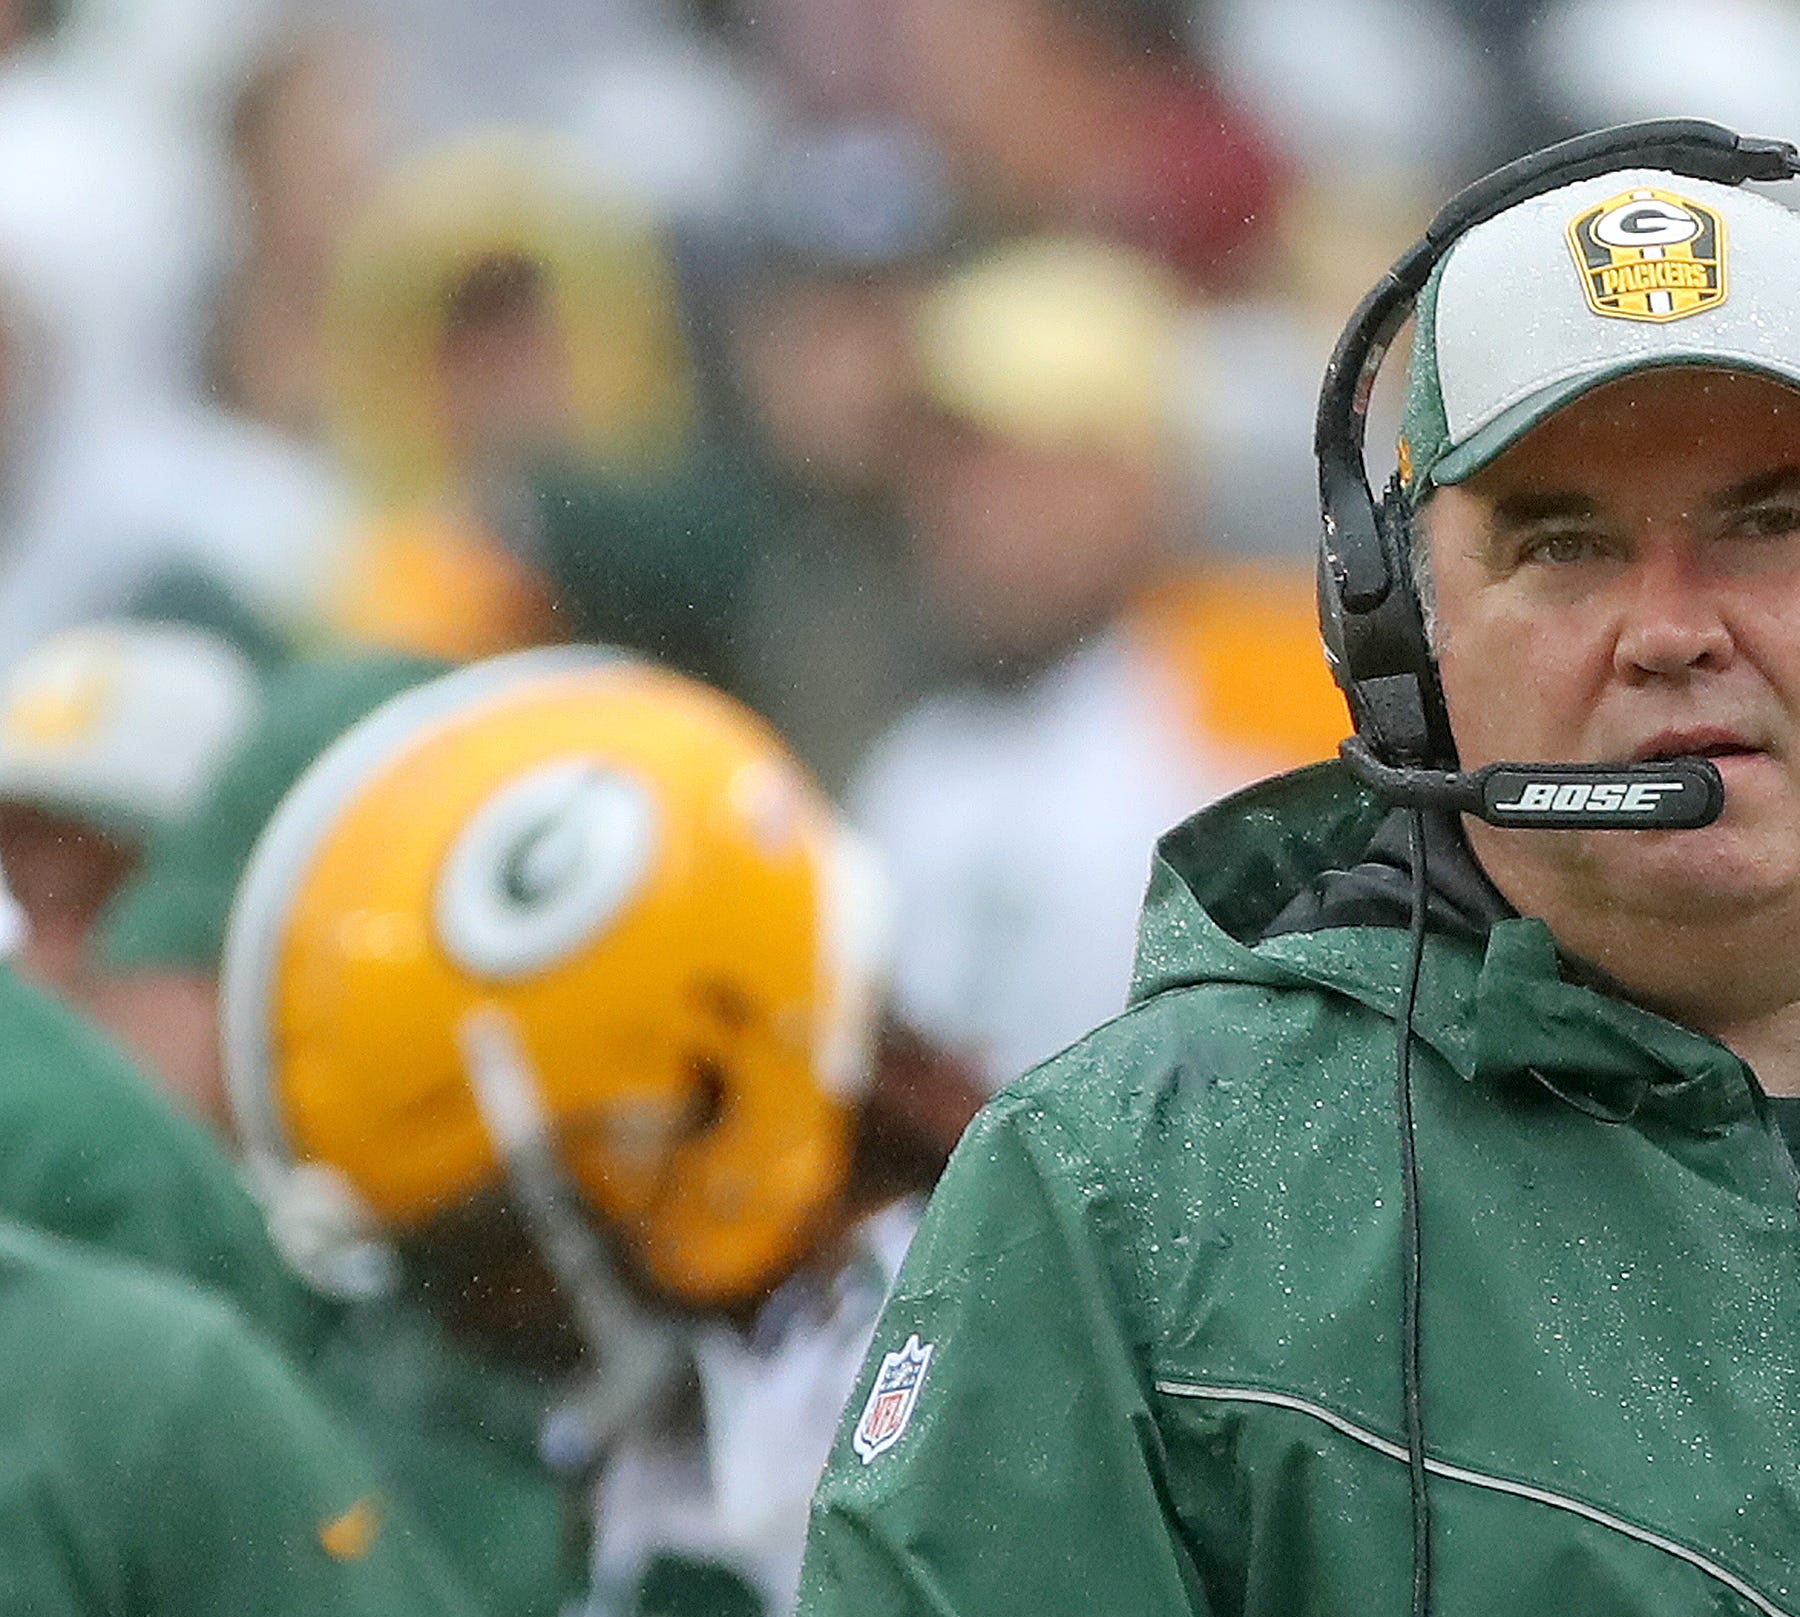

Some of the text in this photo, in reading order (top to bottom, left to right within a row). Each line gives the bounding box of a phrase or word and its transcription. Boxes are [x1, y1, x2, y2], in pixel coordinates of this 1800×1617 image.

[1596, 200, 1697, 246] G
[1600, 261, 1708, 296] PACKERS
[1495, 782, 1685, 812] BOSE
